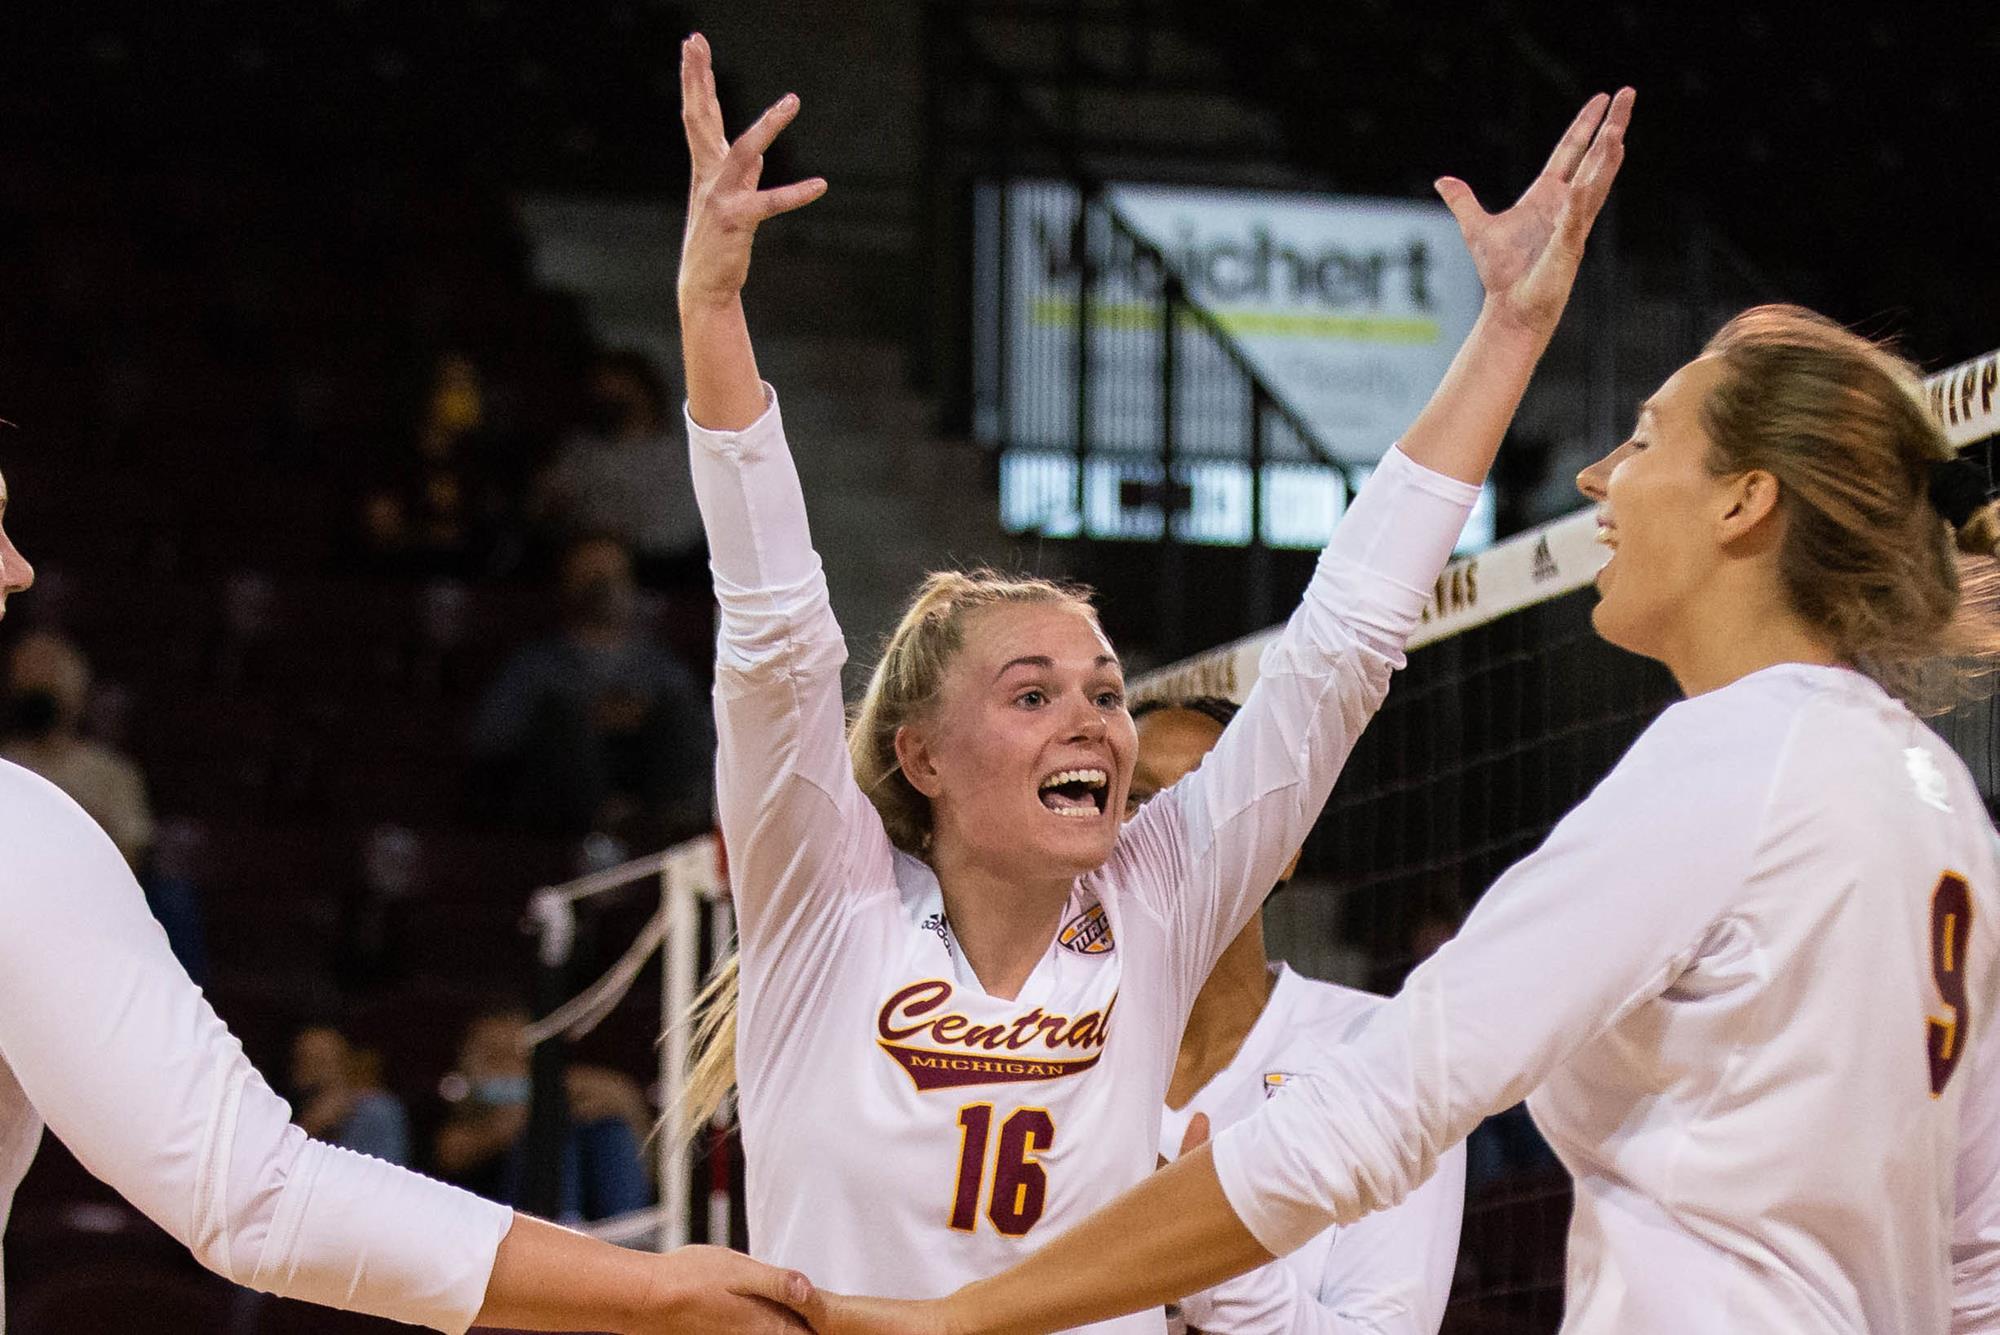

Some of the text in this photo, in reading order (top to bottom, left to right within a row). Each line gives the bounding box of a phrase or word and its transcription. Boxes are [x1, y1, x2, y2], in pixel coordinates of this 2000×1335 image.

[877, 979, 1119, 1050] Central
[1926, 869, 1973, 1099] 9
[909, 1055, 1065, 1076] MICHIGAN
[947, 1101, 1055, 1238] 16
